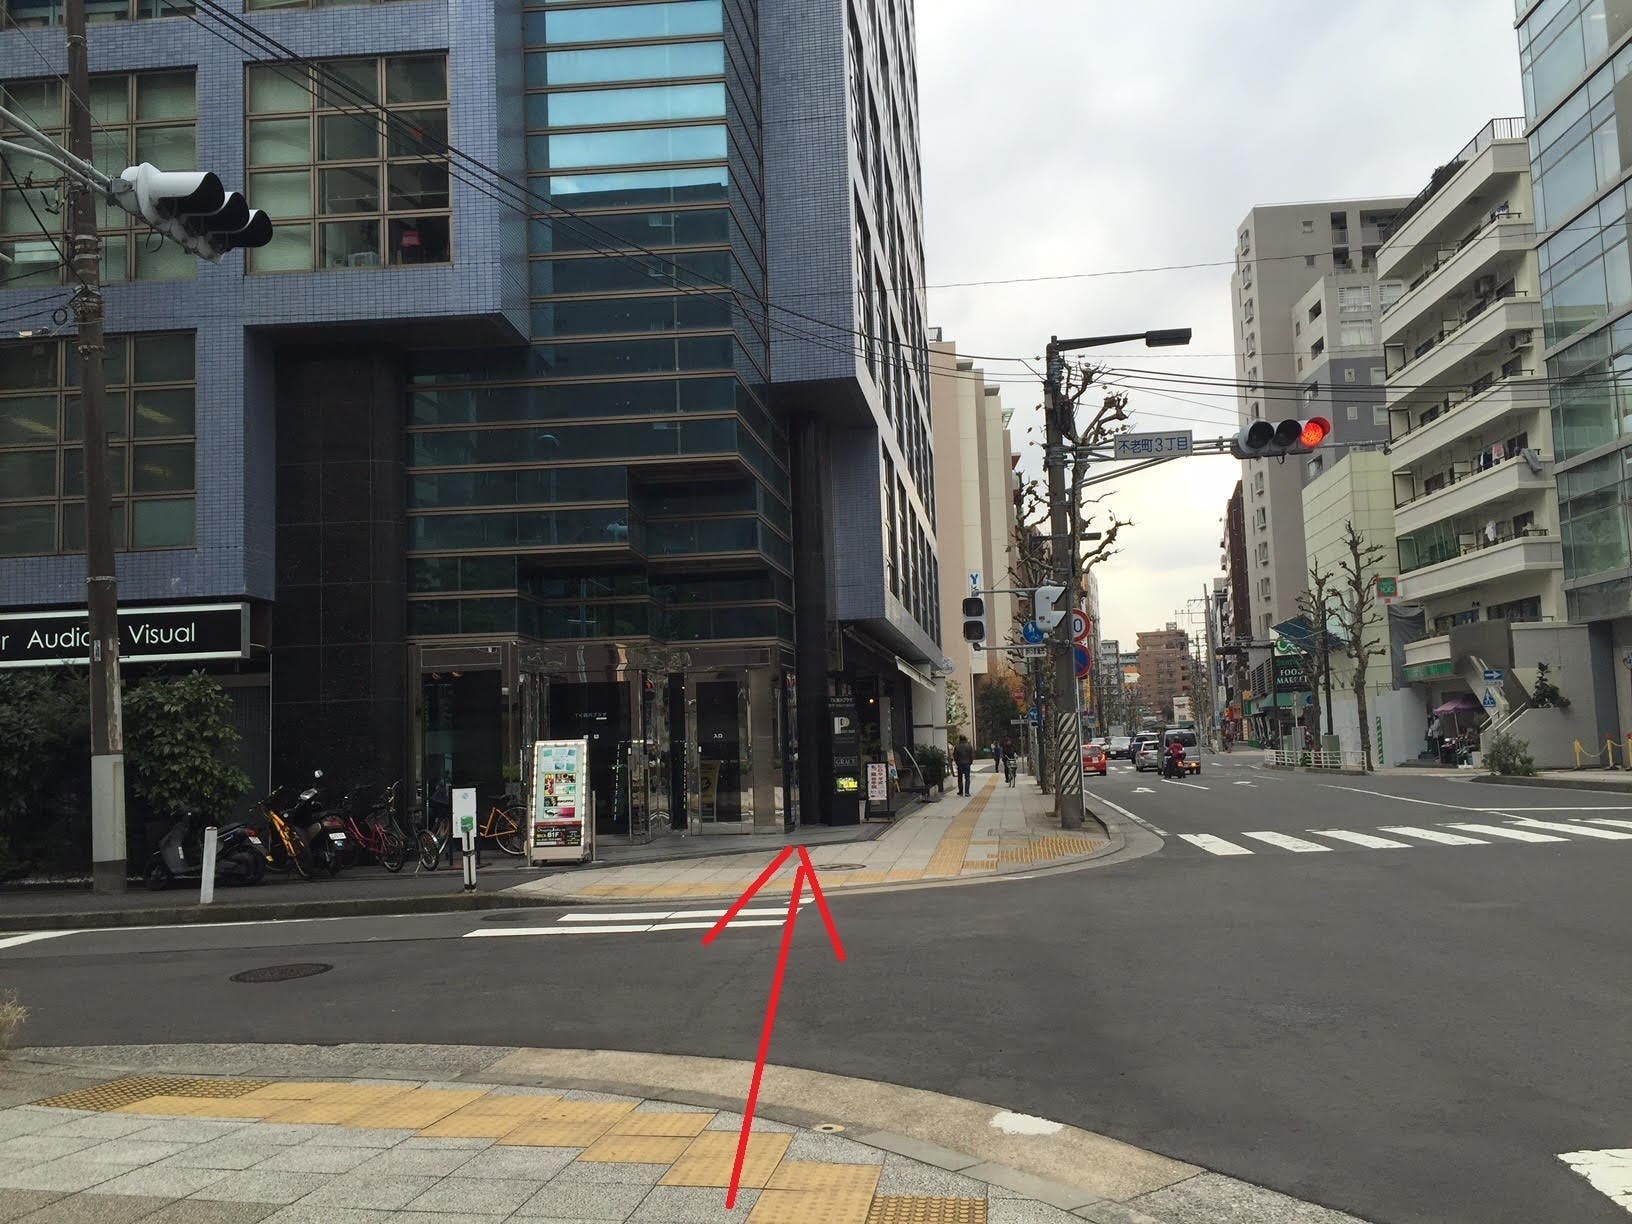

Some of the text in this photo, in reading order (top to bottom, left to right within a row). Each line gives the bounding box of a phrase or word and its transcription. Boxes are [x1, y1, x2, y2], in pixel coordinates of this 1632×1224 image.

[1118, 437, 1188, 454] 不老町3丁目
[1073, 618, 1082, 632] 0
[0, 634, 10, 651] r
[128, 622, 195, 644] Visual
